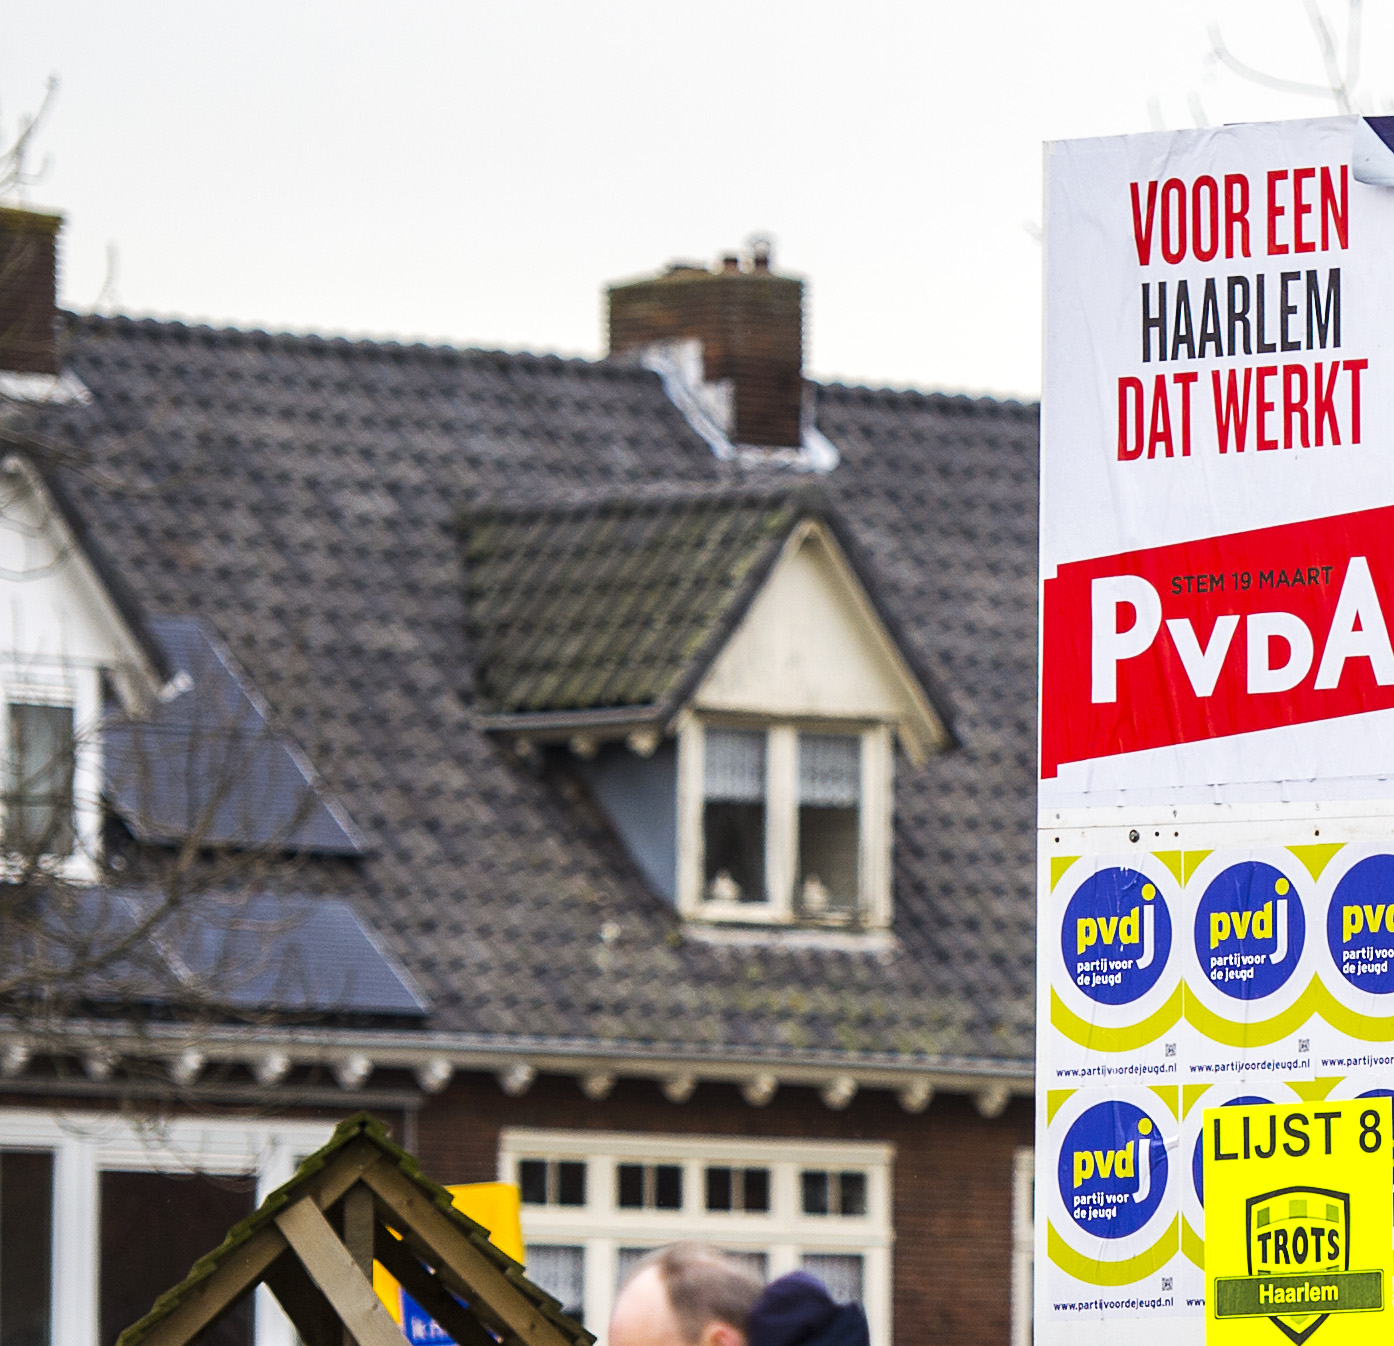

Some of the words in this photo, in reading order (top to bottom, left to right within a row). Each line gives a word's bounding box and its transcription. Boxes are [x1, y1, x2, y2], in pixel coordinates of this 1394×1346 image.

[1130, 174, 1252, 266] VOOR
[1267, 164, 1350, 256] EEN
[1140, 267, 1342, 363] HAARLEM
[1116, 371, 1199, 462] DAT
[1211, 358, 1369, 455] WERKT
[1170, 573, 1225, 596] STEM
[1231, 571, 1252, 592] 19
[1258, 565, 1334, 590] MAART
[1076, 883, 1157, 970] pvdj
[1209, 877, 1290, 965] pvdj
[1076, 957, 1108, 974] partij
[1108, 959, 1134, 971] voor
[1209, 952, 1241, 969] partij
[1241, 954, 1267, 965] voor
[1342, 946, 1374, 962] partij
[1342, 961, 1356, 974] de
[1356, 960, 1388, 976] jeugd
[1076, 973, 1091, 986] de
[1091, 971, 1122, 988] jeugd
[1209, 967, 1223, 981] de
[1224, 966, 1255, 983] jeugd
[1212, 1110, 1343, 1162] LIJST
[1358, 1108, 1383, 1155] 8
[1073, 1117, 1153, 1204] pvdj
[1073, 1191, 1105, 1208] partij
[1073, 1206, 1087, 1219] de
[1256, 1225, 1342, 1267] TROTS
[1258, 1281, 1339, 1306] Haarlem
